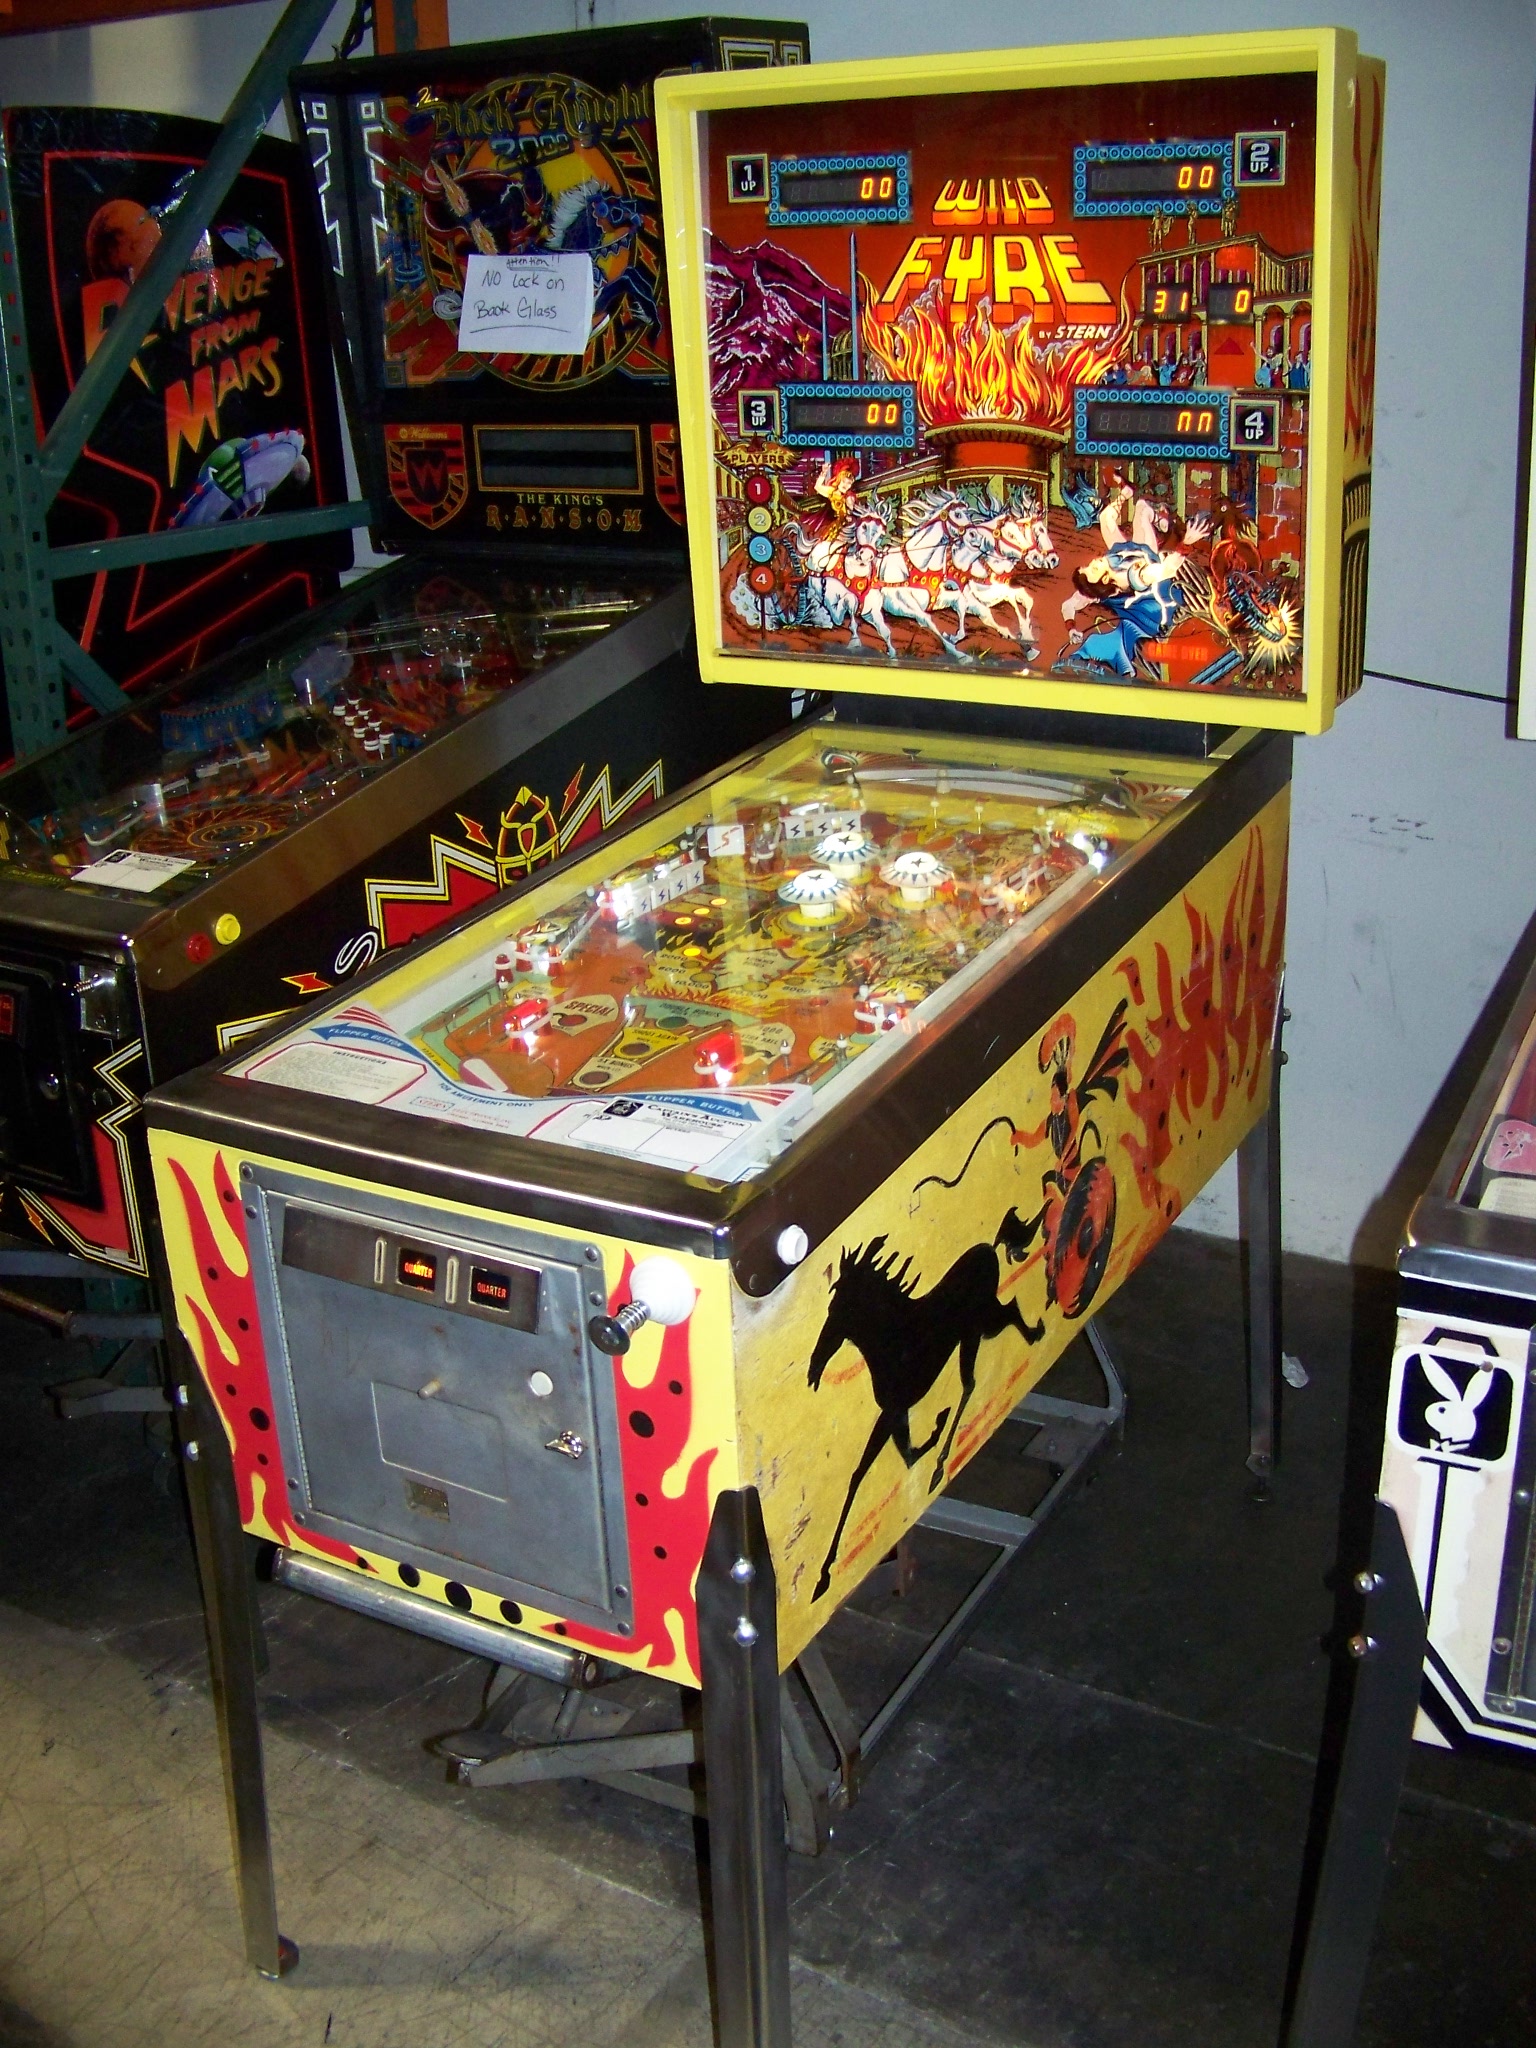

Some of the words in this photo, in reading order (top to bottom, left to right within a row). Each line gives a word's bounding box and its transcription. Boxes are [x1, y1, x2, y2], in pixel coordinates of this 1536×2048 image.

[1250, 143, 1270, 162] 2
[743, 164, 753, 182] 1
[1250, 161, 1269, 173] UP
[740, 181, 757, 192] UP
[933, 177, 1055, 226] WILD
[481, 270, 501, 287] NO
[546, 278, 565, 291] on
[876, 234, 1117, 324] FYRE
[474, 300, 510, 319] Back
[517, 296, 557, 319] Glass
[190, 309, 261, 367] FROM
[1039, 331, 1052, 340] BY
[1055, 325, 1111, 339] STERN
[165, 338, 281, 488] MARS
[750, 400, 766, 416] 3
[751, 416, 766, 426] UP
[1244, 411, 1264, 430] 4
[408, 427, 449, 440] Williams
[1245, 429, 1264, 440] UP
[731, 454, 785, 465] PLAYERS
[755, 483, 762, 495] 1
[517, 492, 546, 505] THE
[553, 493, 604, 506] KING'S
[754, 514, 766, 526] 2
[755, 543, 767, 556] 3
[755, 573, 767, 585] 4
[1181, 646, 1207, 662] OVER
[564, 1000, 615, 1017] SPECIAL
[328, 1027, 369, 1038] FLIPPER
[370, 1034, 403, 1048] BUTTON
[438, 1082, 450, 1092] FOR
[450, 1091, 503, 1107] AMUSEMENT
[645, 1094, 696, 1105] FLIPPER
[700, 1102, 742, 1118] BUTTON
[404, 1261, 433, 1279] QUARTER
[476, 1282, 507, 1299] QUARTER
